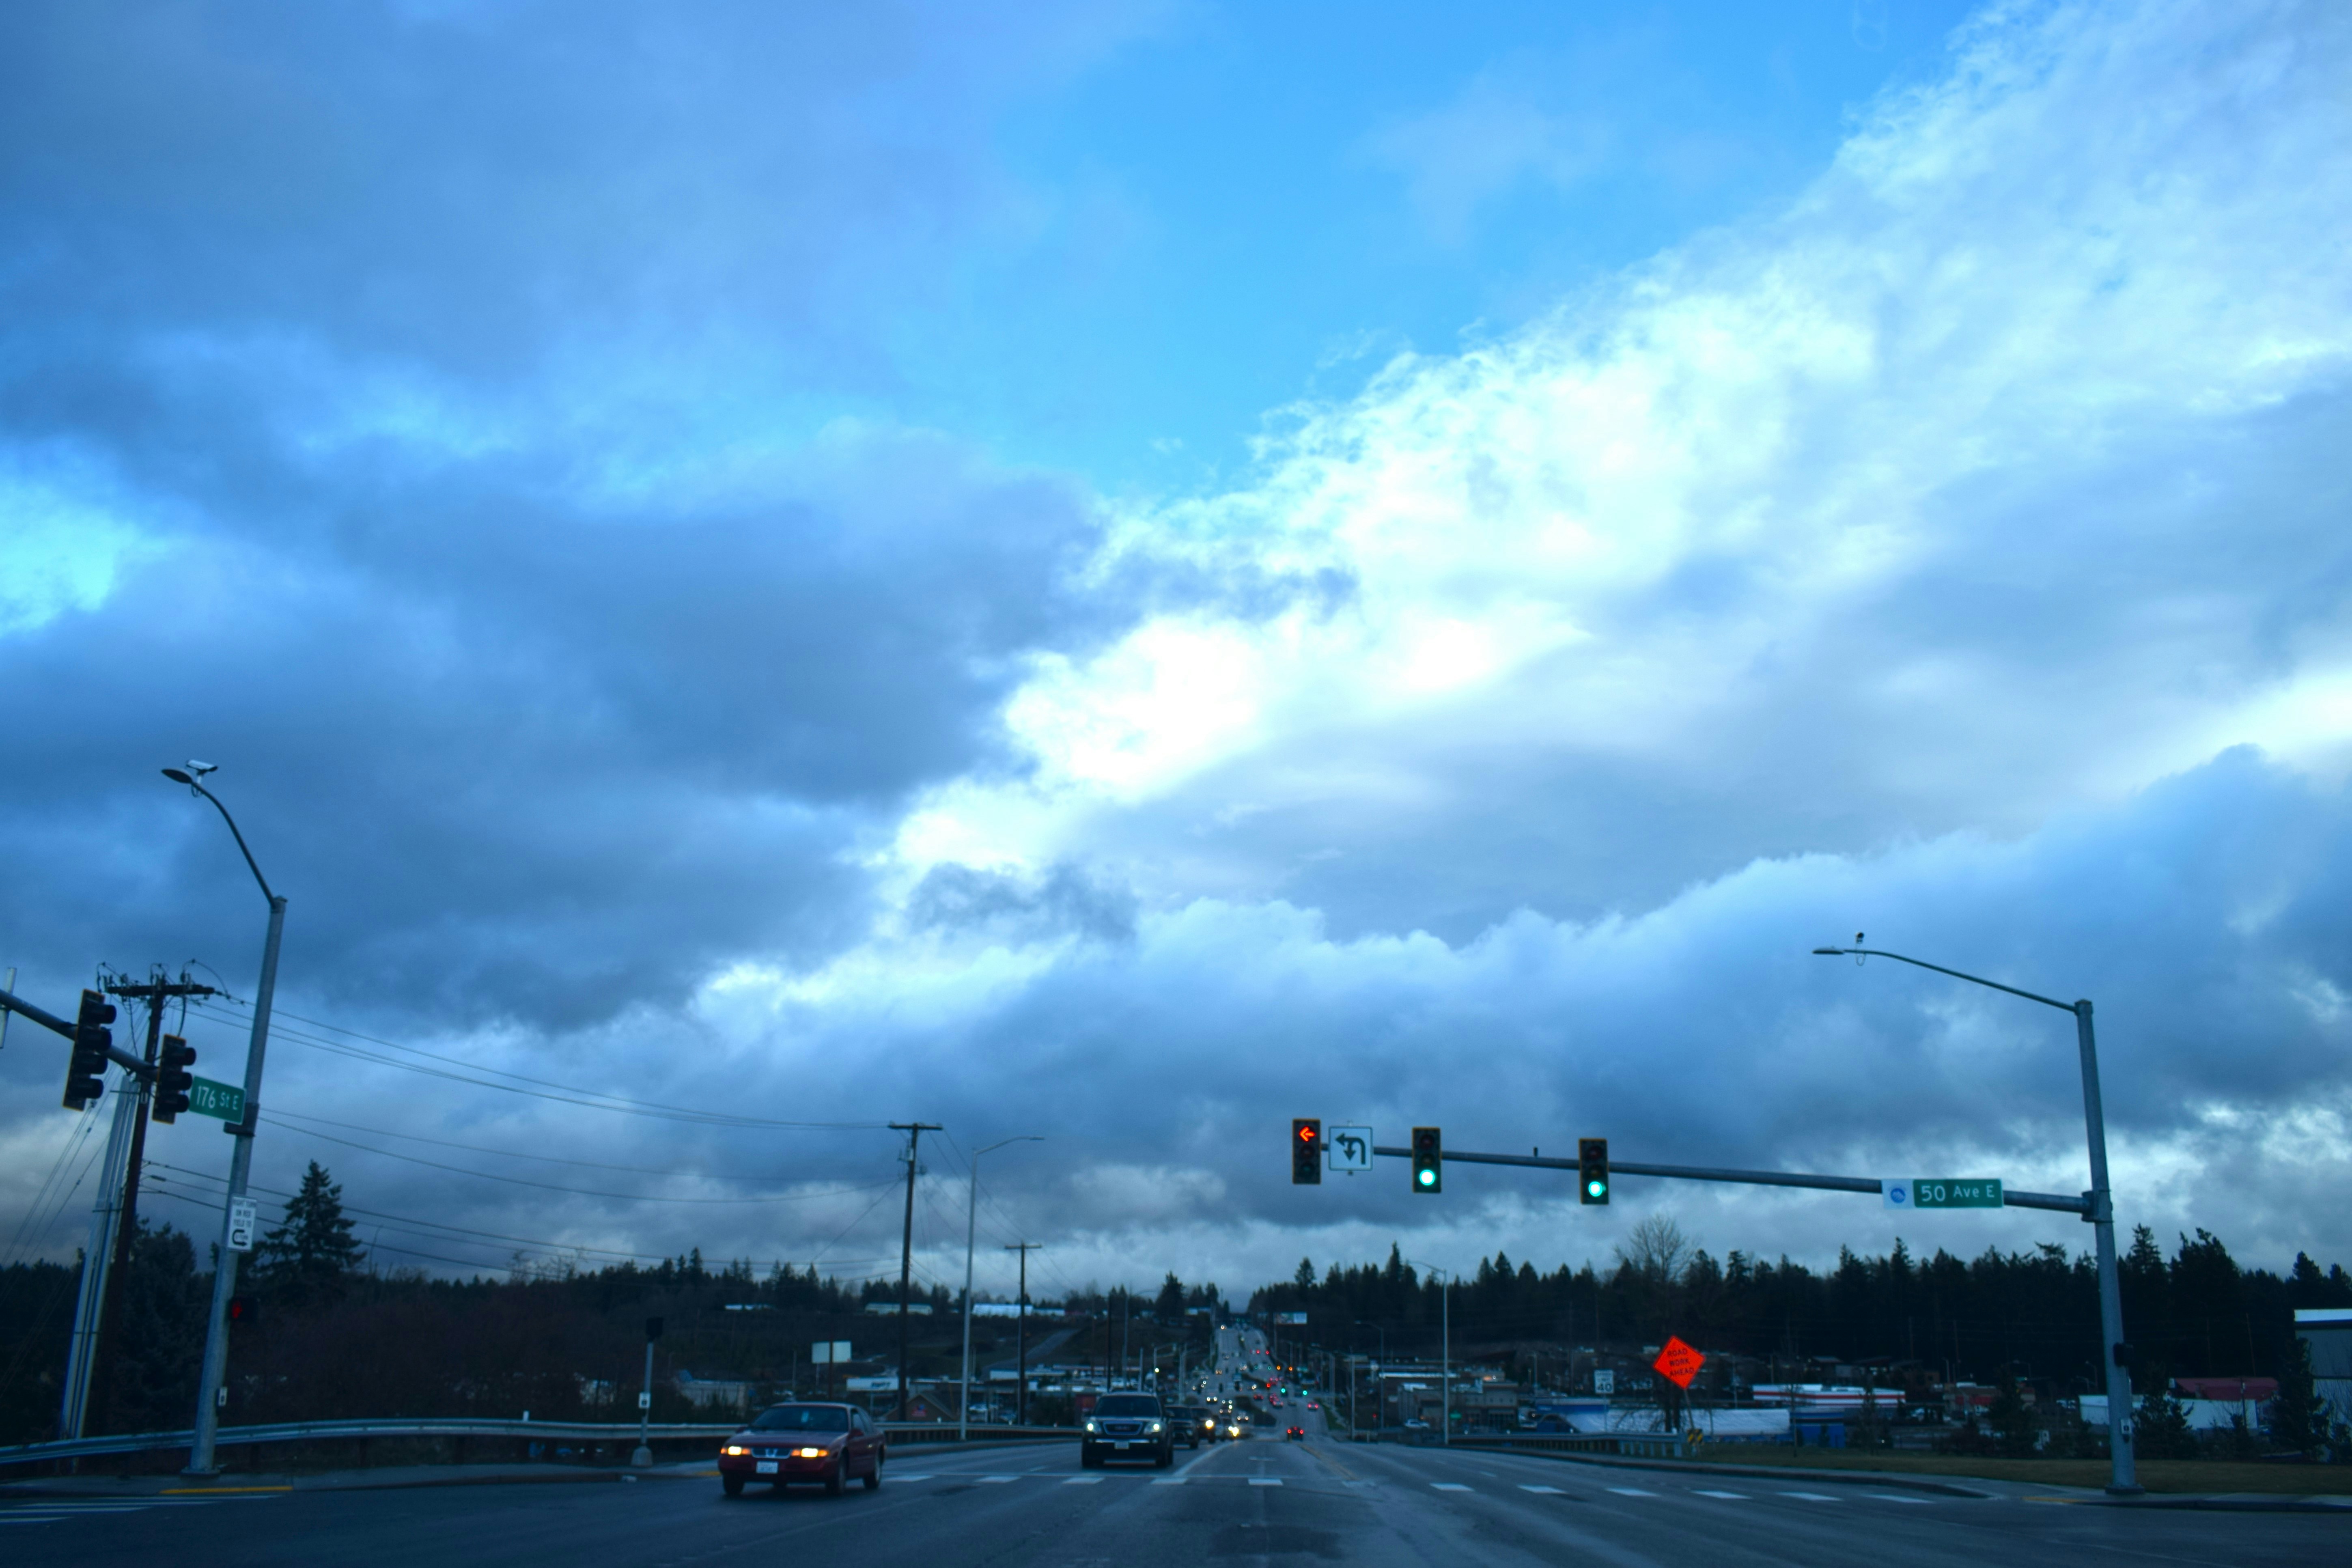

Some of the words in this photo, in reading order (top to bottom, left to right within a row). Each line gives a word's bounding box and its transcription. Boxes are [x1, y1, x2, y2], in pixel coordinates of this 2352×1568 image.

[196, 1085, 215, 1109] 176
[220, 1092, 230, 1108] St
[233, 1095, 239, 1110] E
[1921, 1185, 1946, 1202] 50
[1954, 1185, 1980, 1198] Ave
[1986, 1185, 1995, 1198] E
[1667, 1348, 1687, 1357] ROAD
[1669, 1359, 1689, 1367] WORK
[1669, 1367, 1695, 1376] AHEAD
[1597, 1383, 1612, 1392] 40
